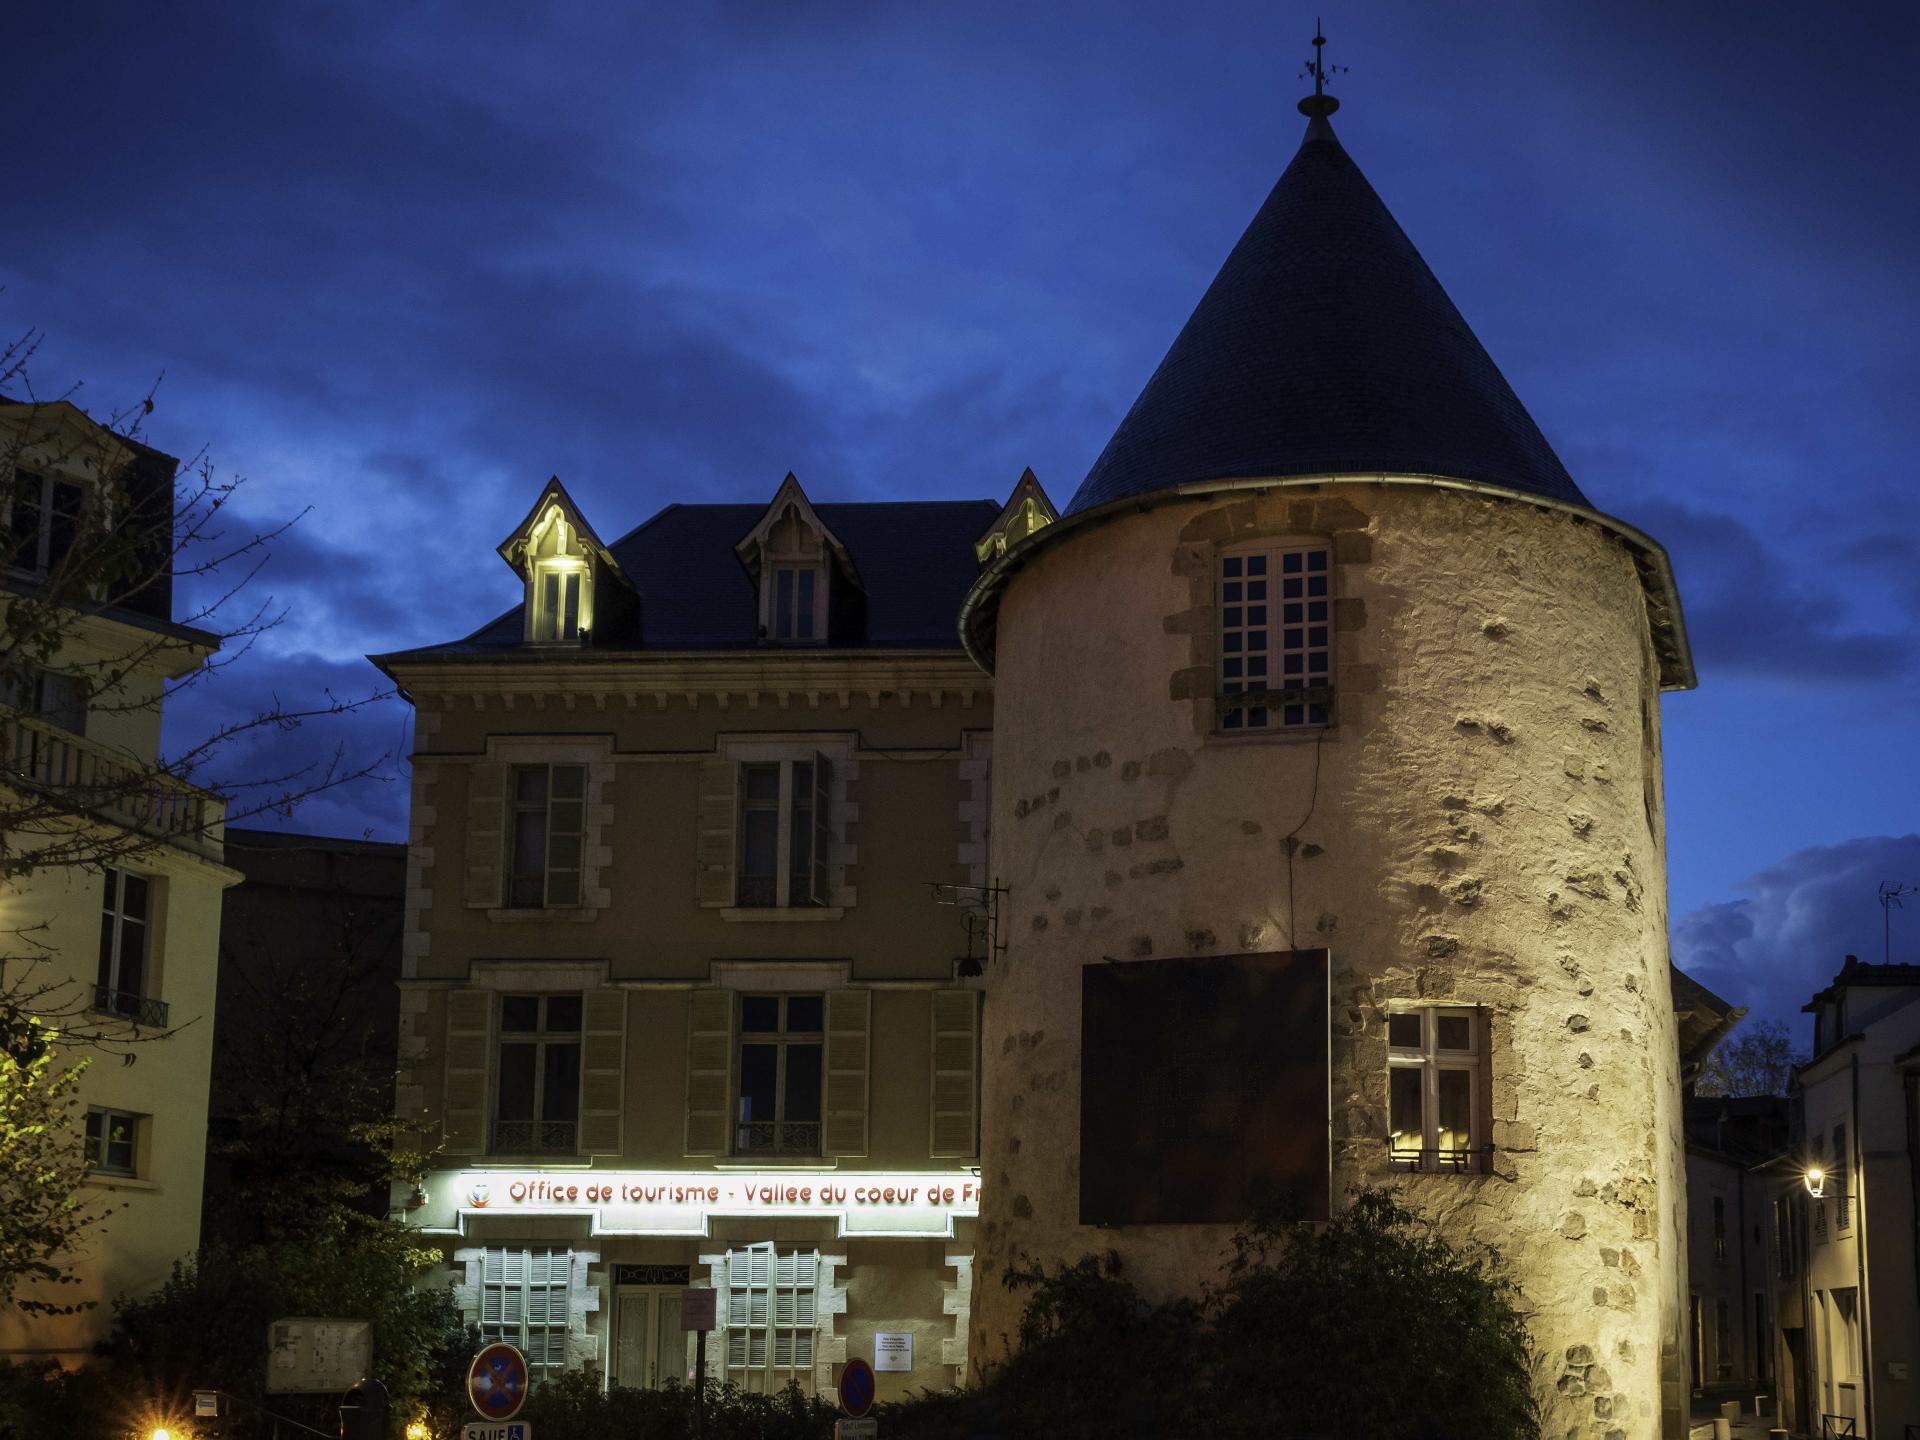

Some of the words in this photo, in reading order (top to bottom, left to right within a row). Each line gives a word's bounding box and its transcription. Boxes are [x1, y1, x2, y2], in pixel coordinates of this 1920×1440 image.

[509, 1181, 579, 1201] Office
[586, 1182, 613, 1201] de
[621, 1182, 719, 1201] tourisme
[744, 1183, 812, 1202] Vallee
[819, 1183, 846, 1202] du
[854, 1185, 919, 1202] coeur
[927, 1183, 955, 1203] de
